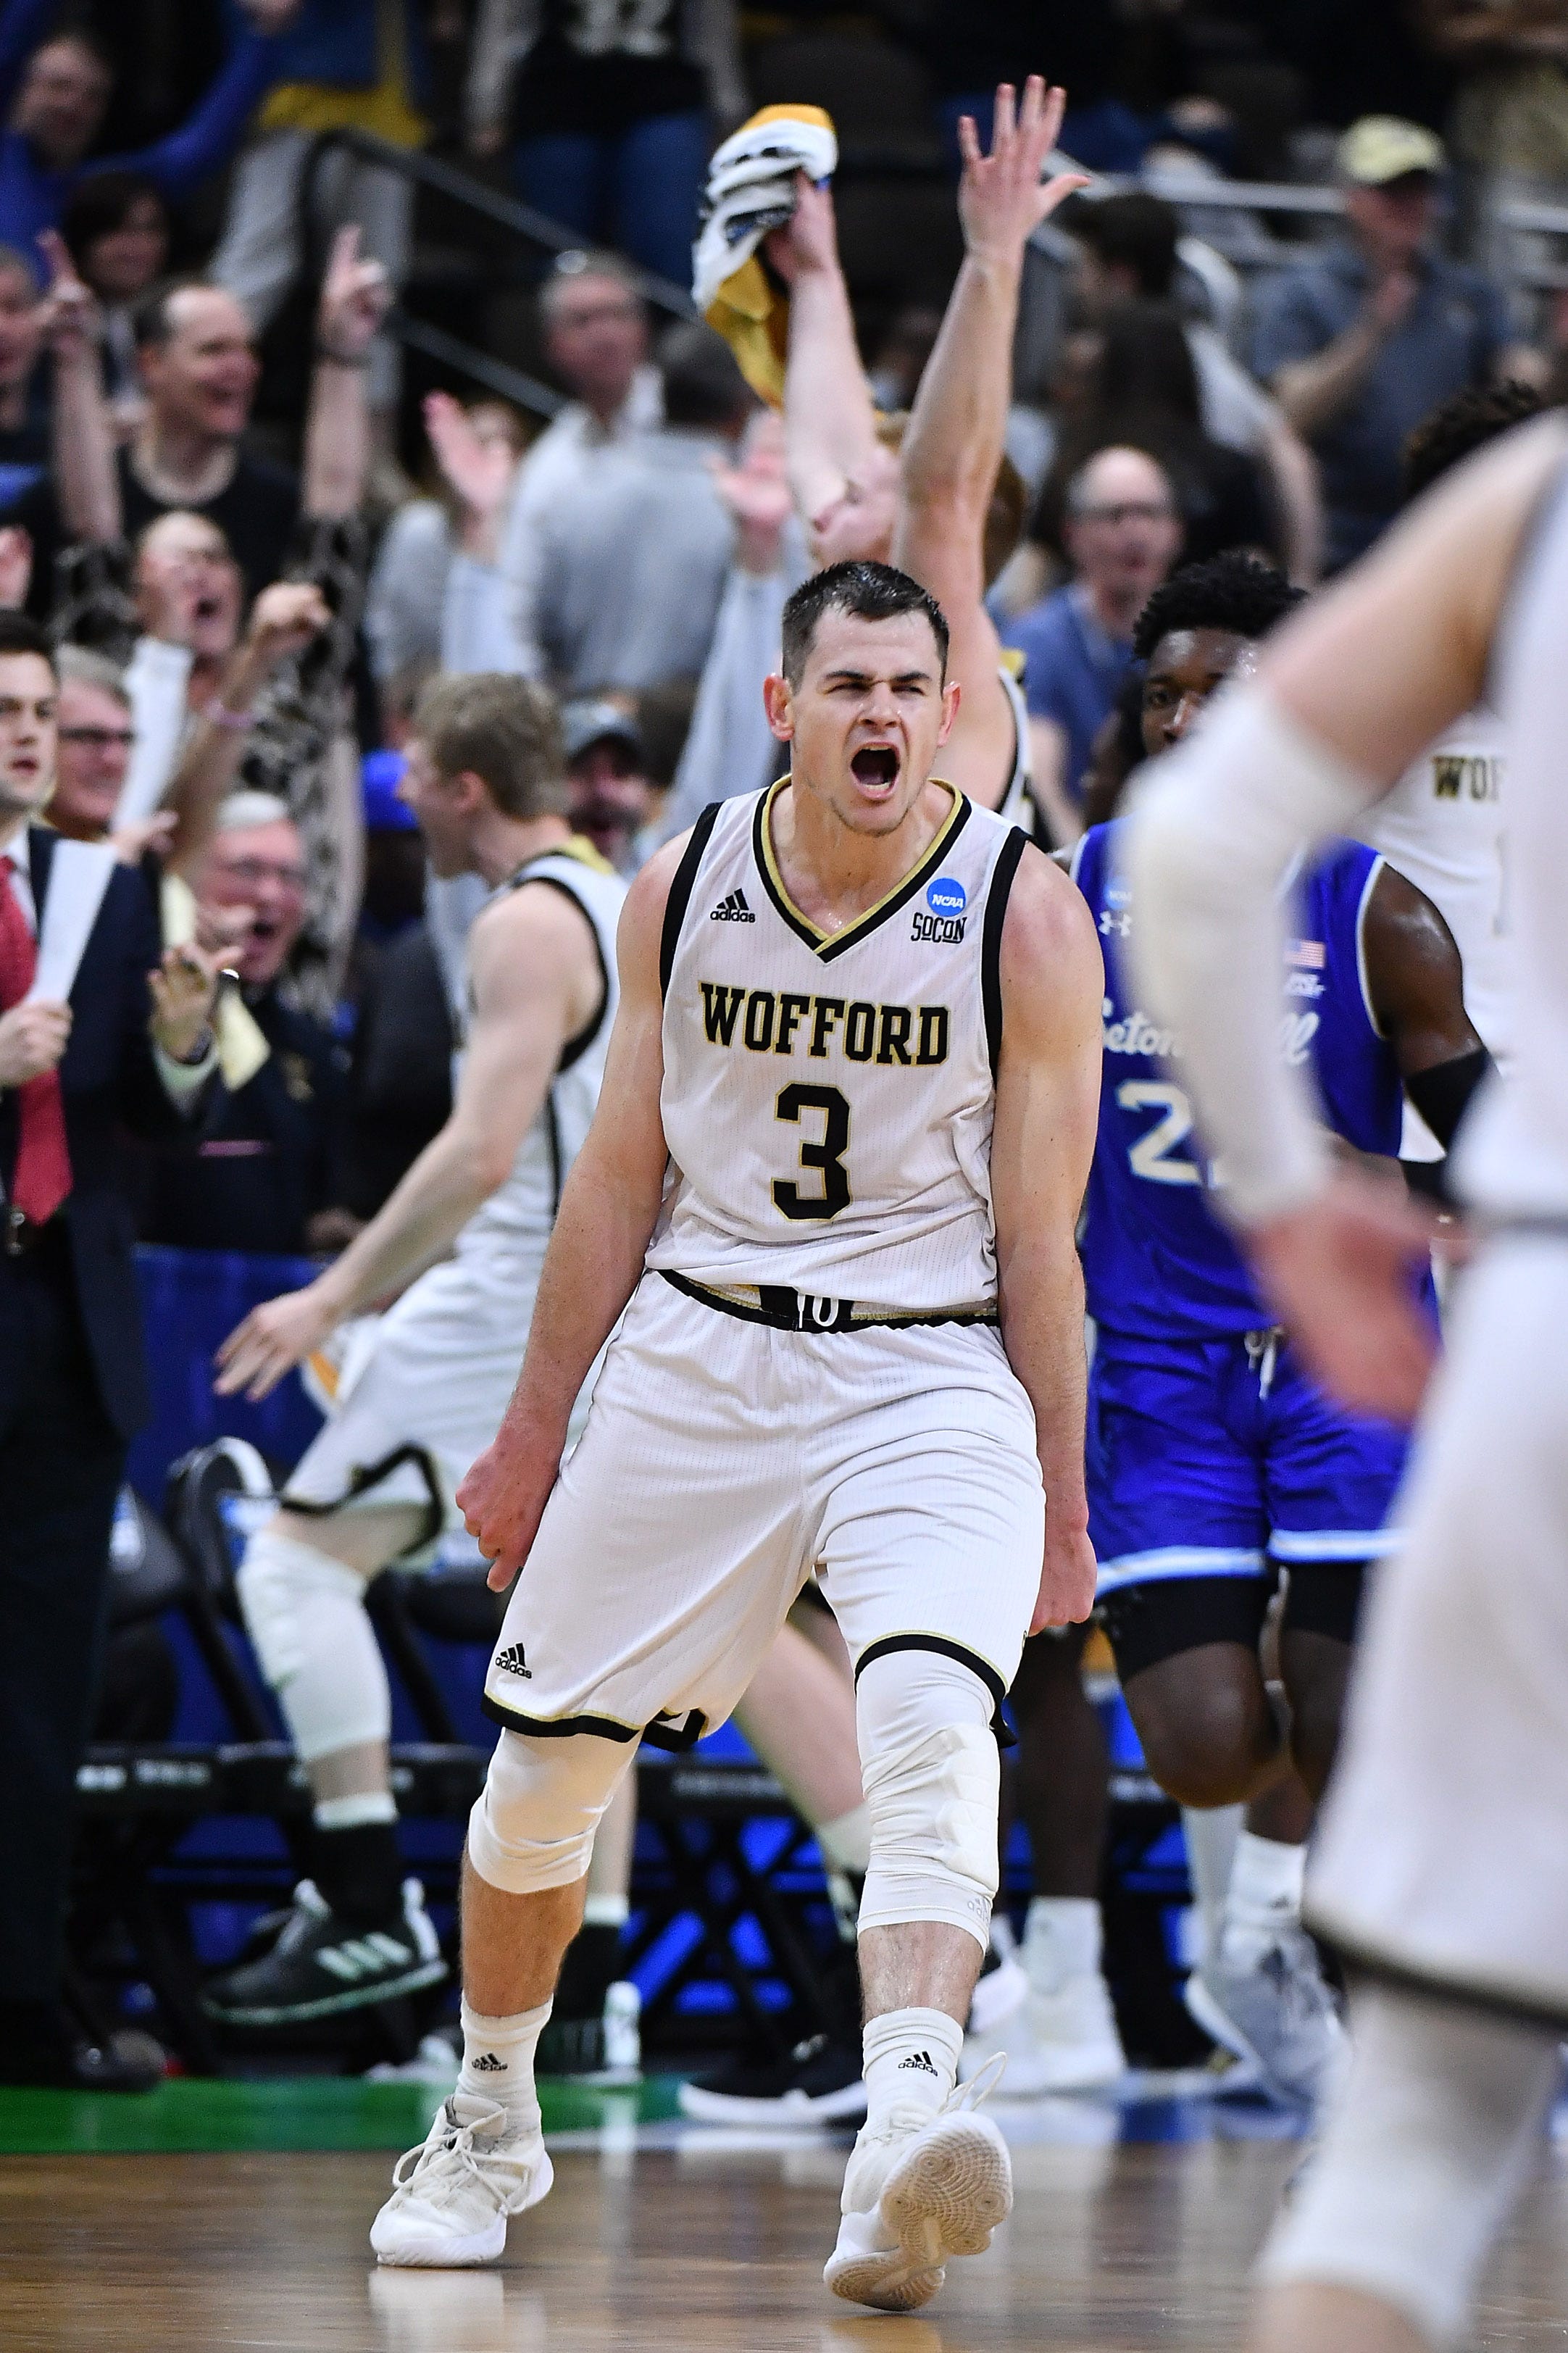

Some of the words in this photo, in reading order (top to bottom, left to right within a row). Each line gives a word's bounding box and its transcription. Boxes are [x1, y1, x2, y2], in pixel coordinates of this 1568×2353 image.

[932, 894, 964, 908] NCAA
[710, 909, 756, 923] adidas
[698, 980, 950, 1067] WOFFORD
[1102, 998, 1183, 1057] eton
[771, 1081, 852, 1222] 3
[496, 1657, 532, 1679] adidas
[898, 2061, 938, 2077] adidas
